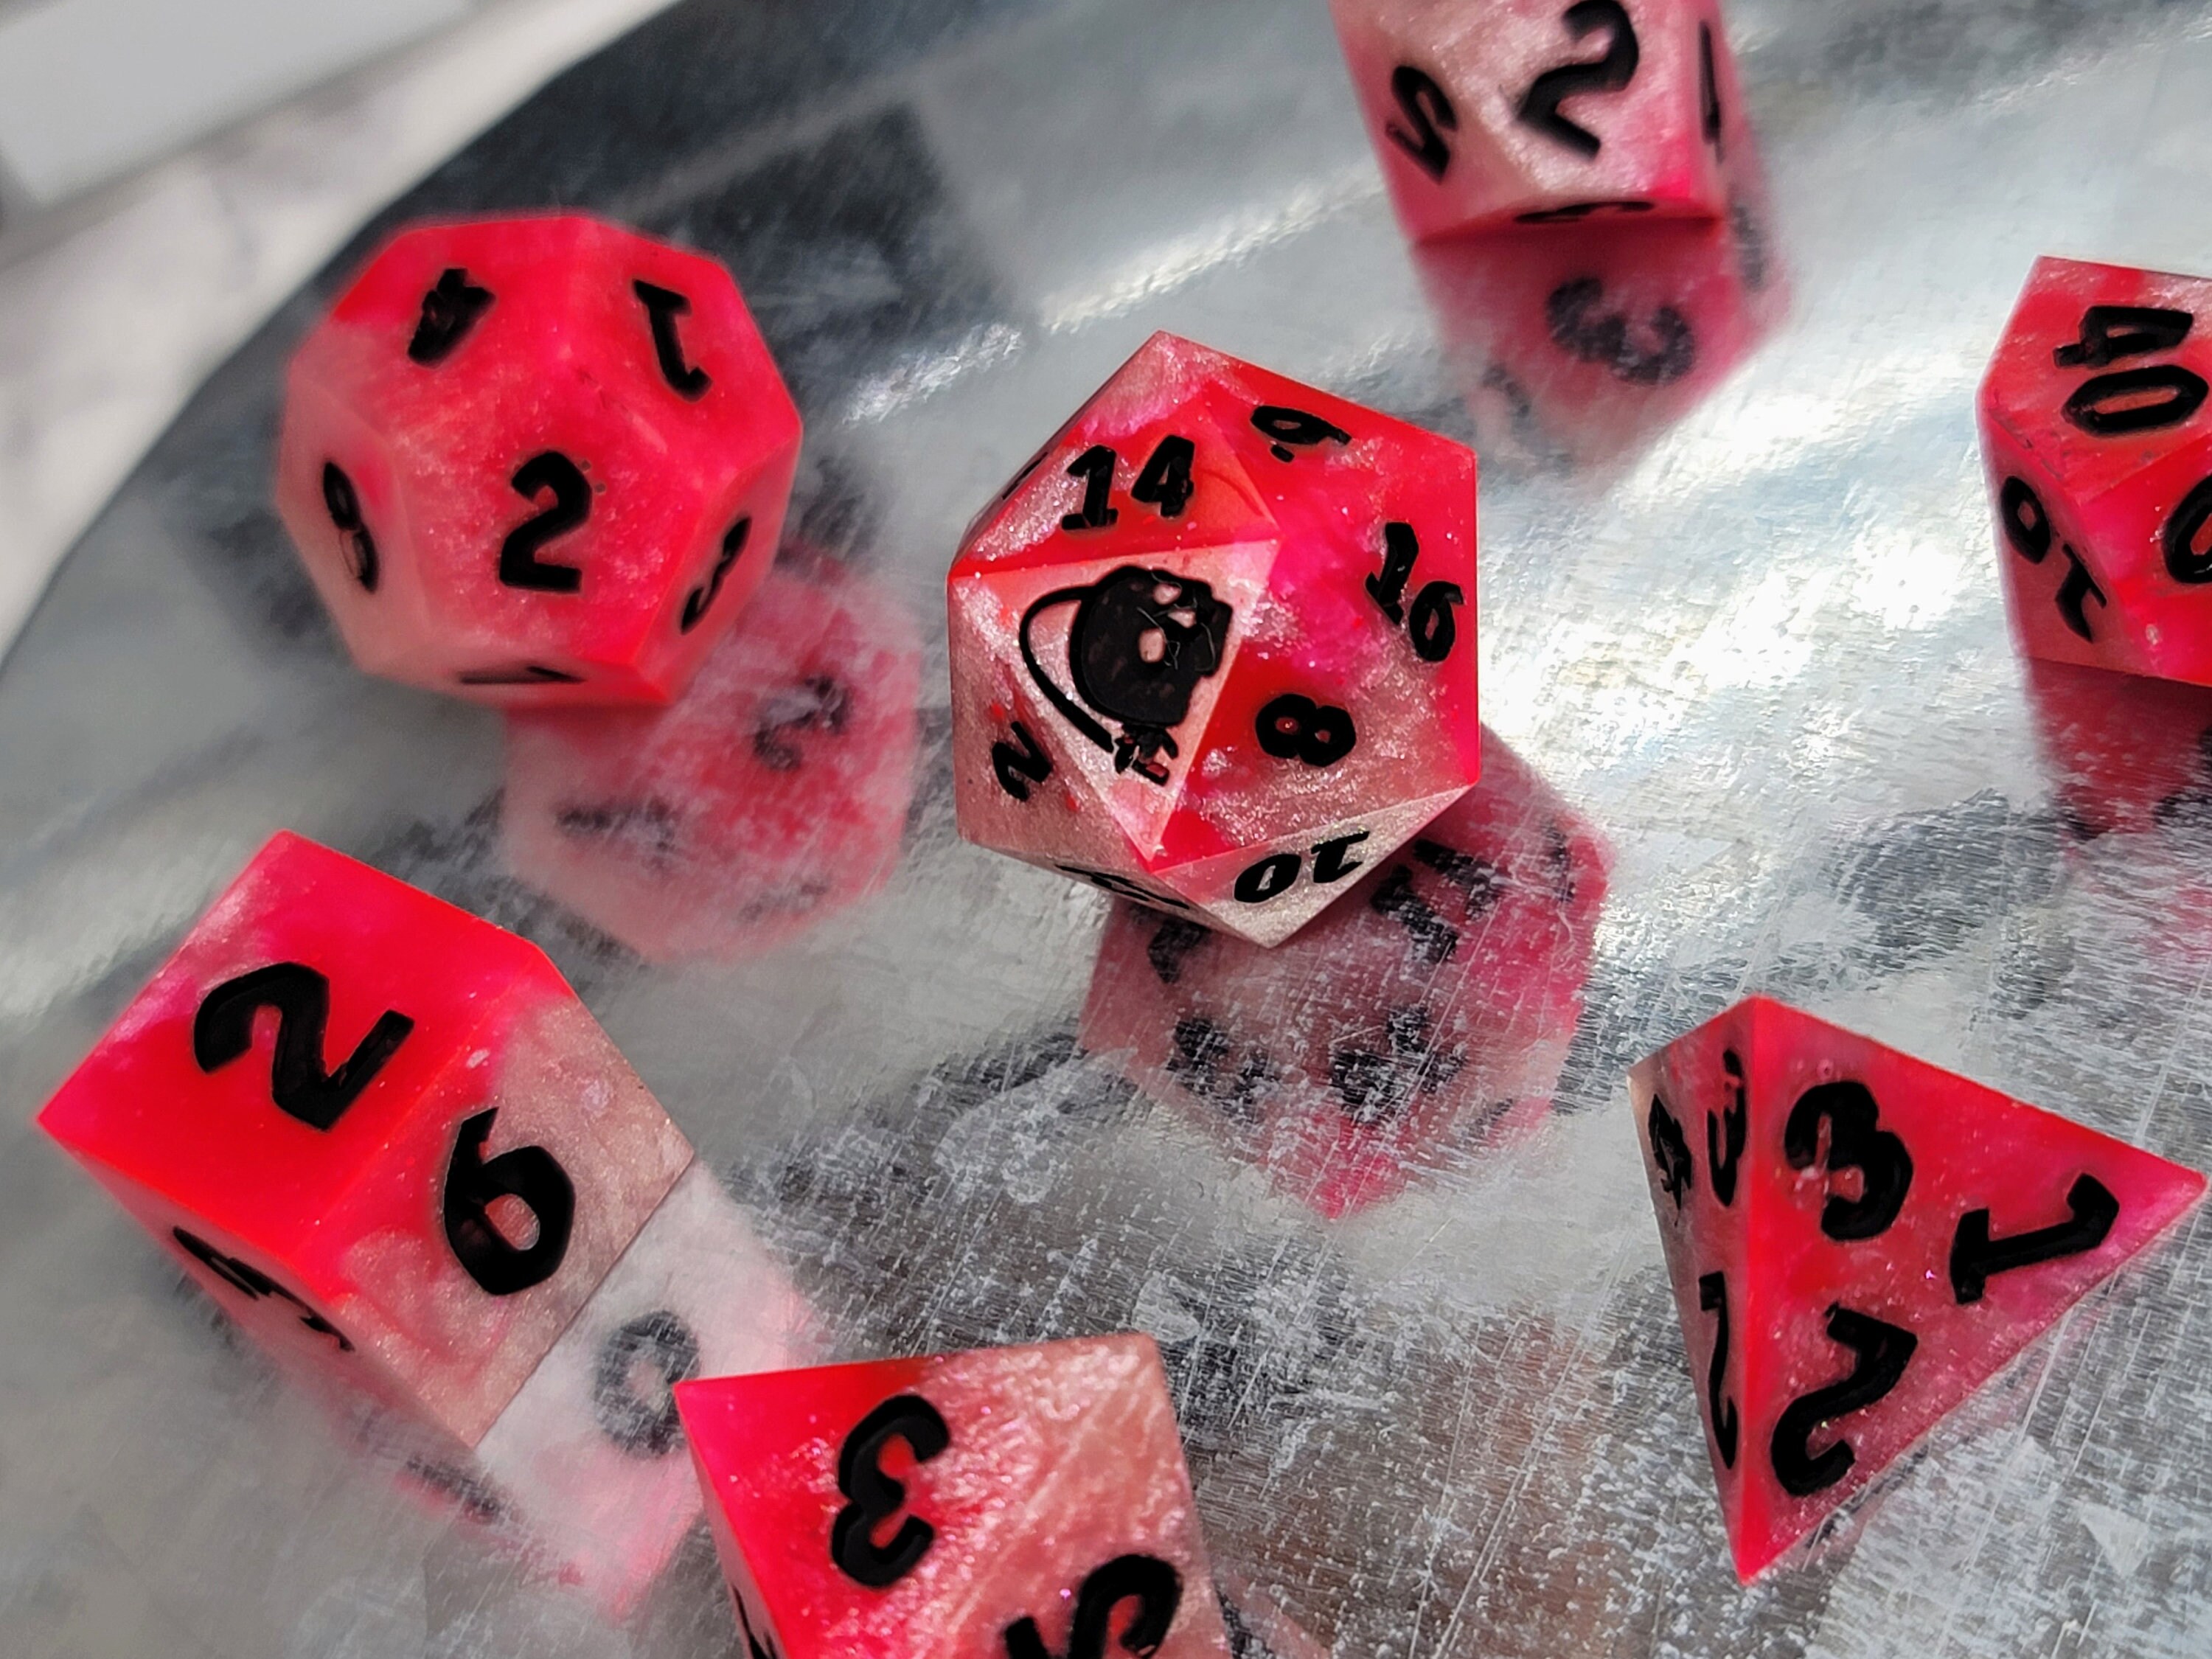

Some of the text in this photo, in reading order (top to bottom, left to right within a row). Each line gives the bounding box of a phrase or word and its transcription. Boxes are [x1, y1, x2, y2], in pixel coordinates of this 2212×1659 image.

[1515, 0, 1640, 157] 2
[633, 279, 709, 398] 1
[2055, 305, 2210, 437] 40
[498, 450, 592, 594] 2
[1060, 434, 1195, 532] 14
[1364, 521, 1464, 664] 16
[1253, 692, 1357, 769] 8
[1233, 830, 1374, 910] 10
[192, 961, 414, 1133] 2
[440, 1107, 576, 1297] 6
[1782, 1078, 1914, 1243] 3
[1948, 1172, 2121, 1307] 1
[1769, 1301, 1919, 1499] 2
[830, 1394, 951, 1590] 3
